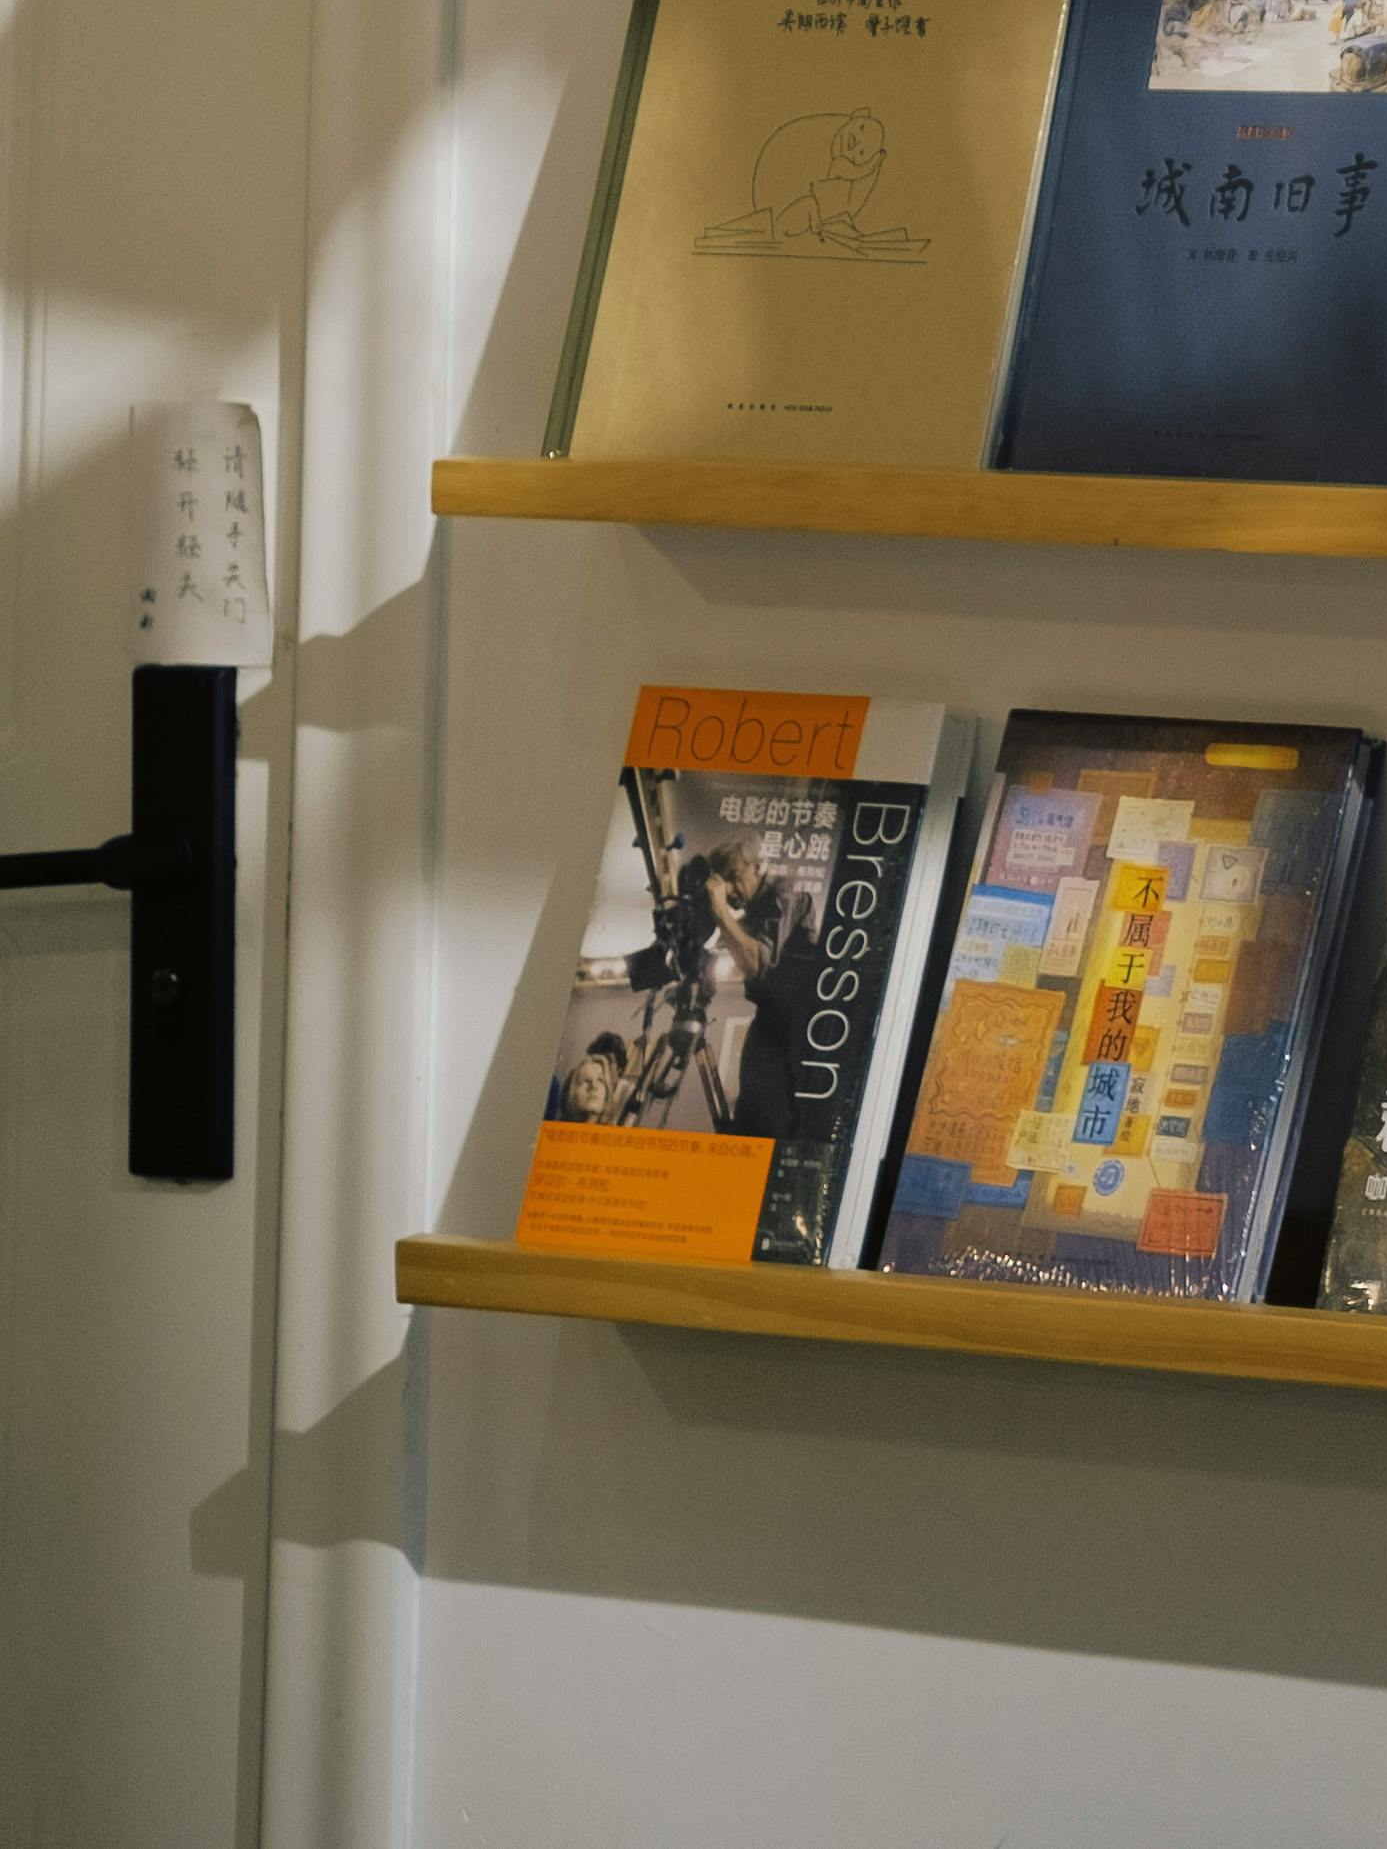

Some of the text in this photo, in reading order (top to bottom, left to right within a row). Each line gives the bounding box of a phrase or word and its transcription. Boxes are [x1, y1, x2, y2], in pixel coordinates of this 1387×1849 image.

[1135, 151, 1379, 238] 城南旧事
[647, 695, 856, 771] Robert
[718, 795, 838, 830] 电影的节奏
[757, 831, 832, 861] 是心跳
[793, 801, 911, 1101] Bresson
[1081, 876, 1164, 1139] 不属于我的城市
